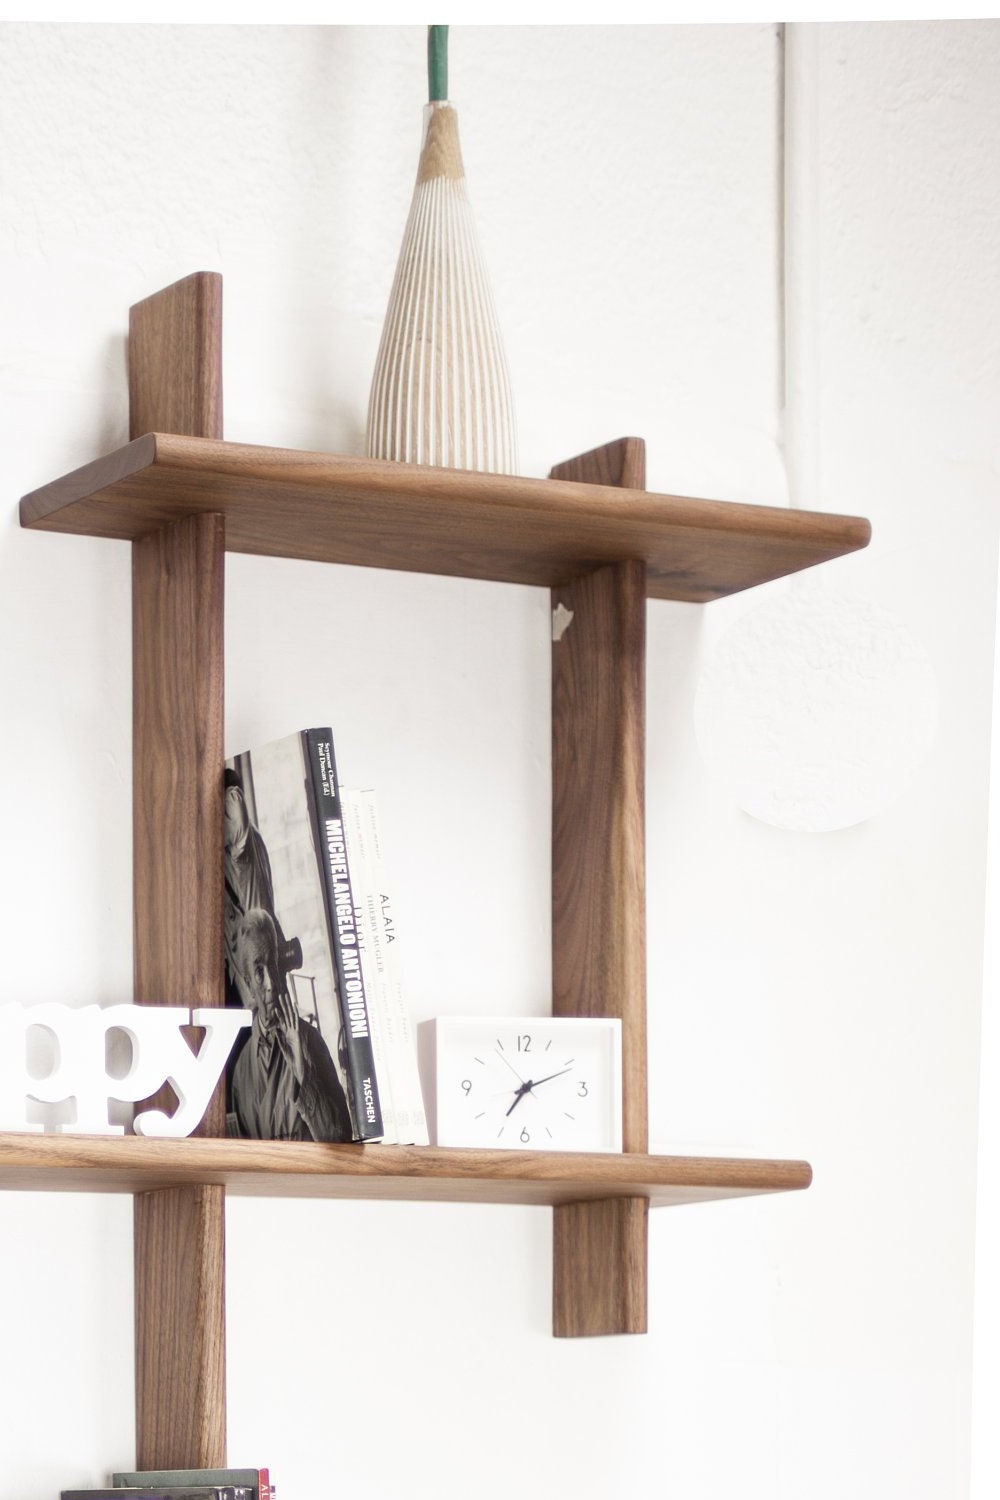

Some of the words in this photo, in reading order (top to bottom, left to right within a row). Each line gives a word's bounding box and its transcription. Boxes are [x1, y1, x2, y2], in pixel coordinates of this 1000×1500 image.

[319, 757, 327, 780] Duncan
[325, 818, 357, 945] MICHELANGELO
[341, 948, 369, 1039] ANTONIONI
[517, 1034, 532, 1053] 12
[461, 1079, 472, 1097] 9
[577, 1081, 589, 1098] 3
[362, 1077, 377, 1123] TASCHEN
[519, 1126, 531, 1144] 6
